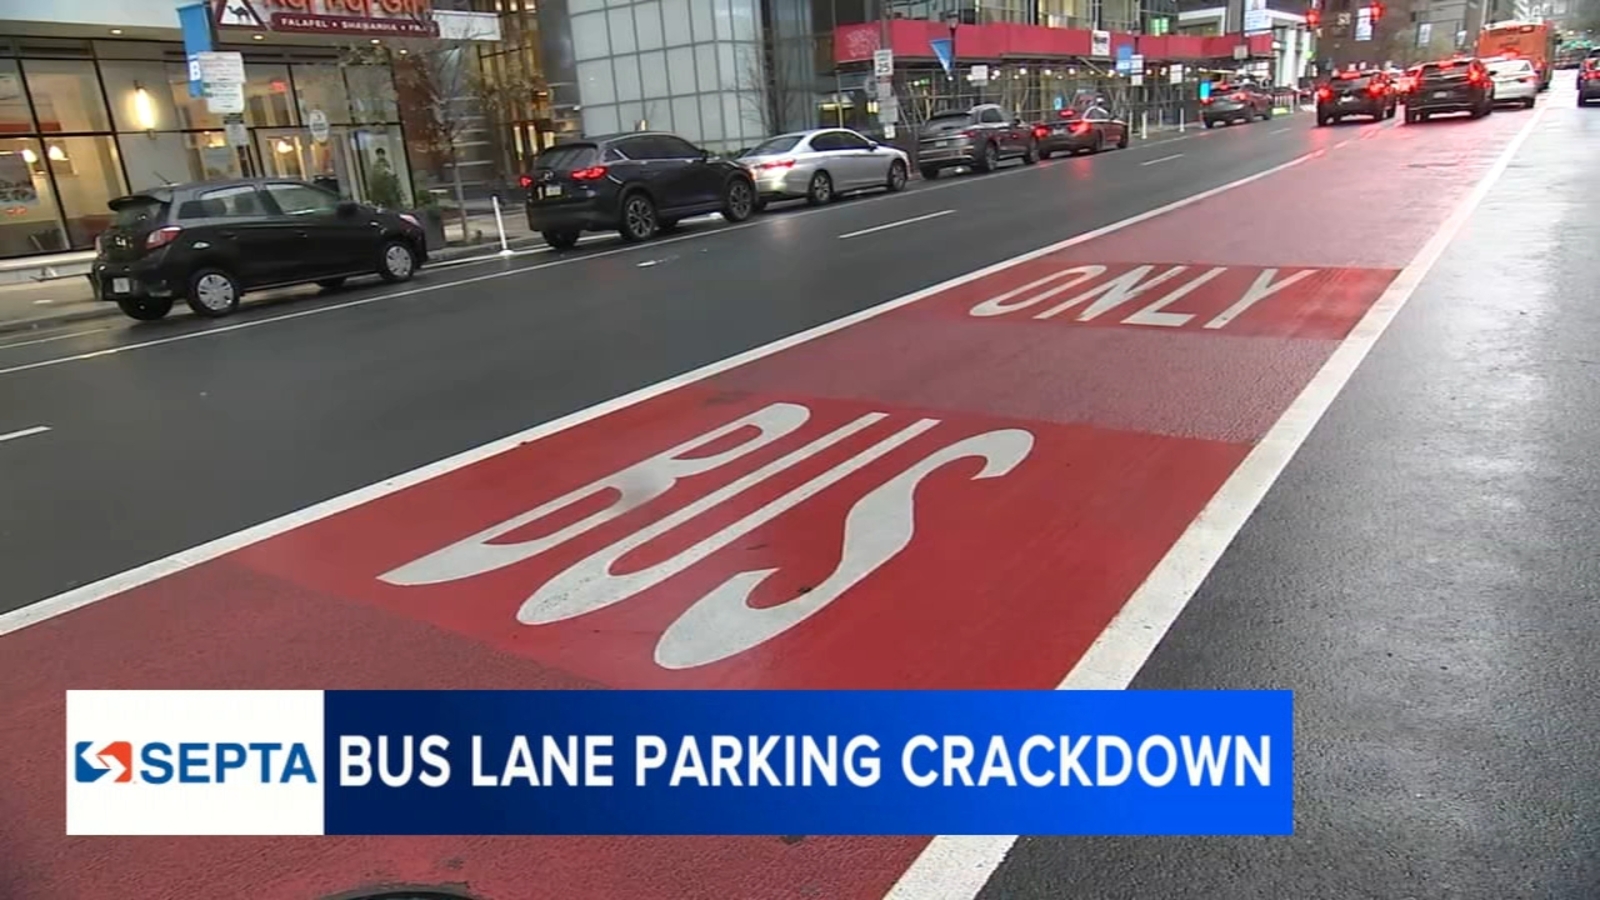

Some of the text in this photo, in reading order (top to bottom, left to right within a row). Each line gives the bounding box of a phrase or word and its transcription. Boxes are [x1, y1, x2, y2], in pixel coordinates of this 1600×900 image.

[281, 17, 328, 29] FALAFEL
[969, 264, 1319, 329] ONLY
[376, 402, 1035, 670] BUS
